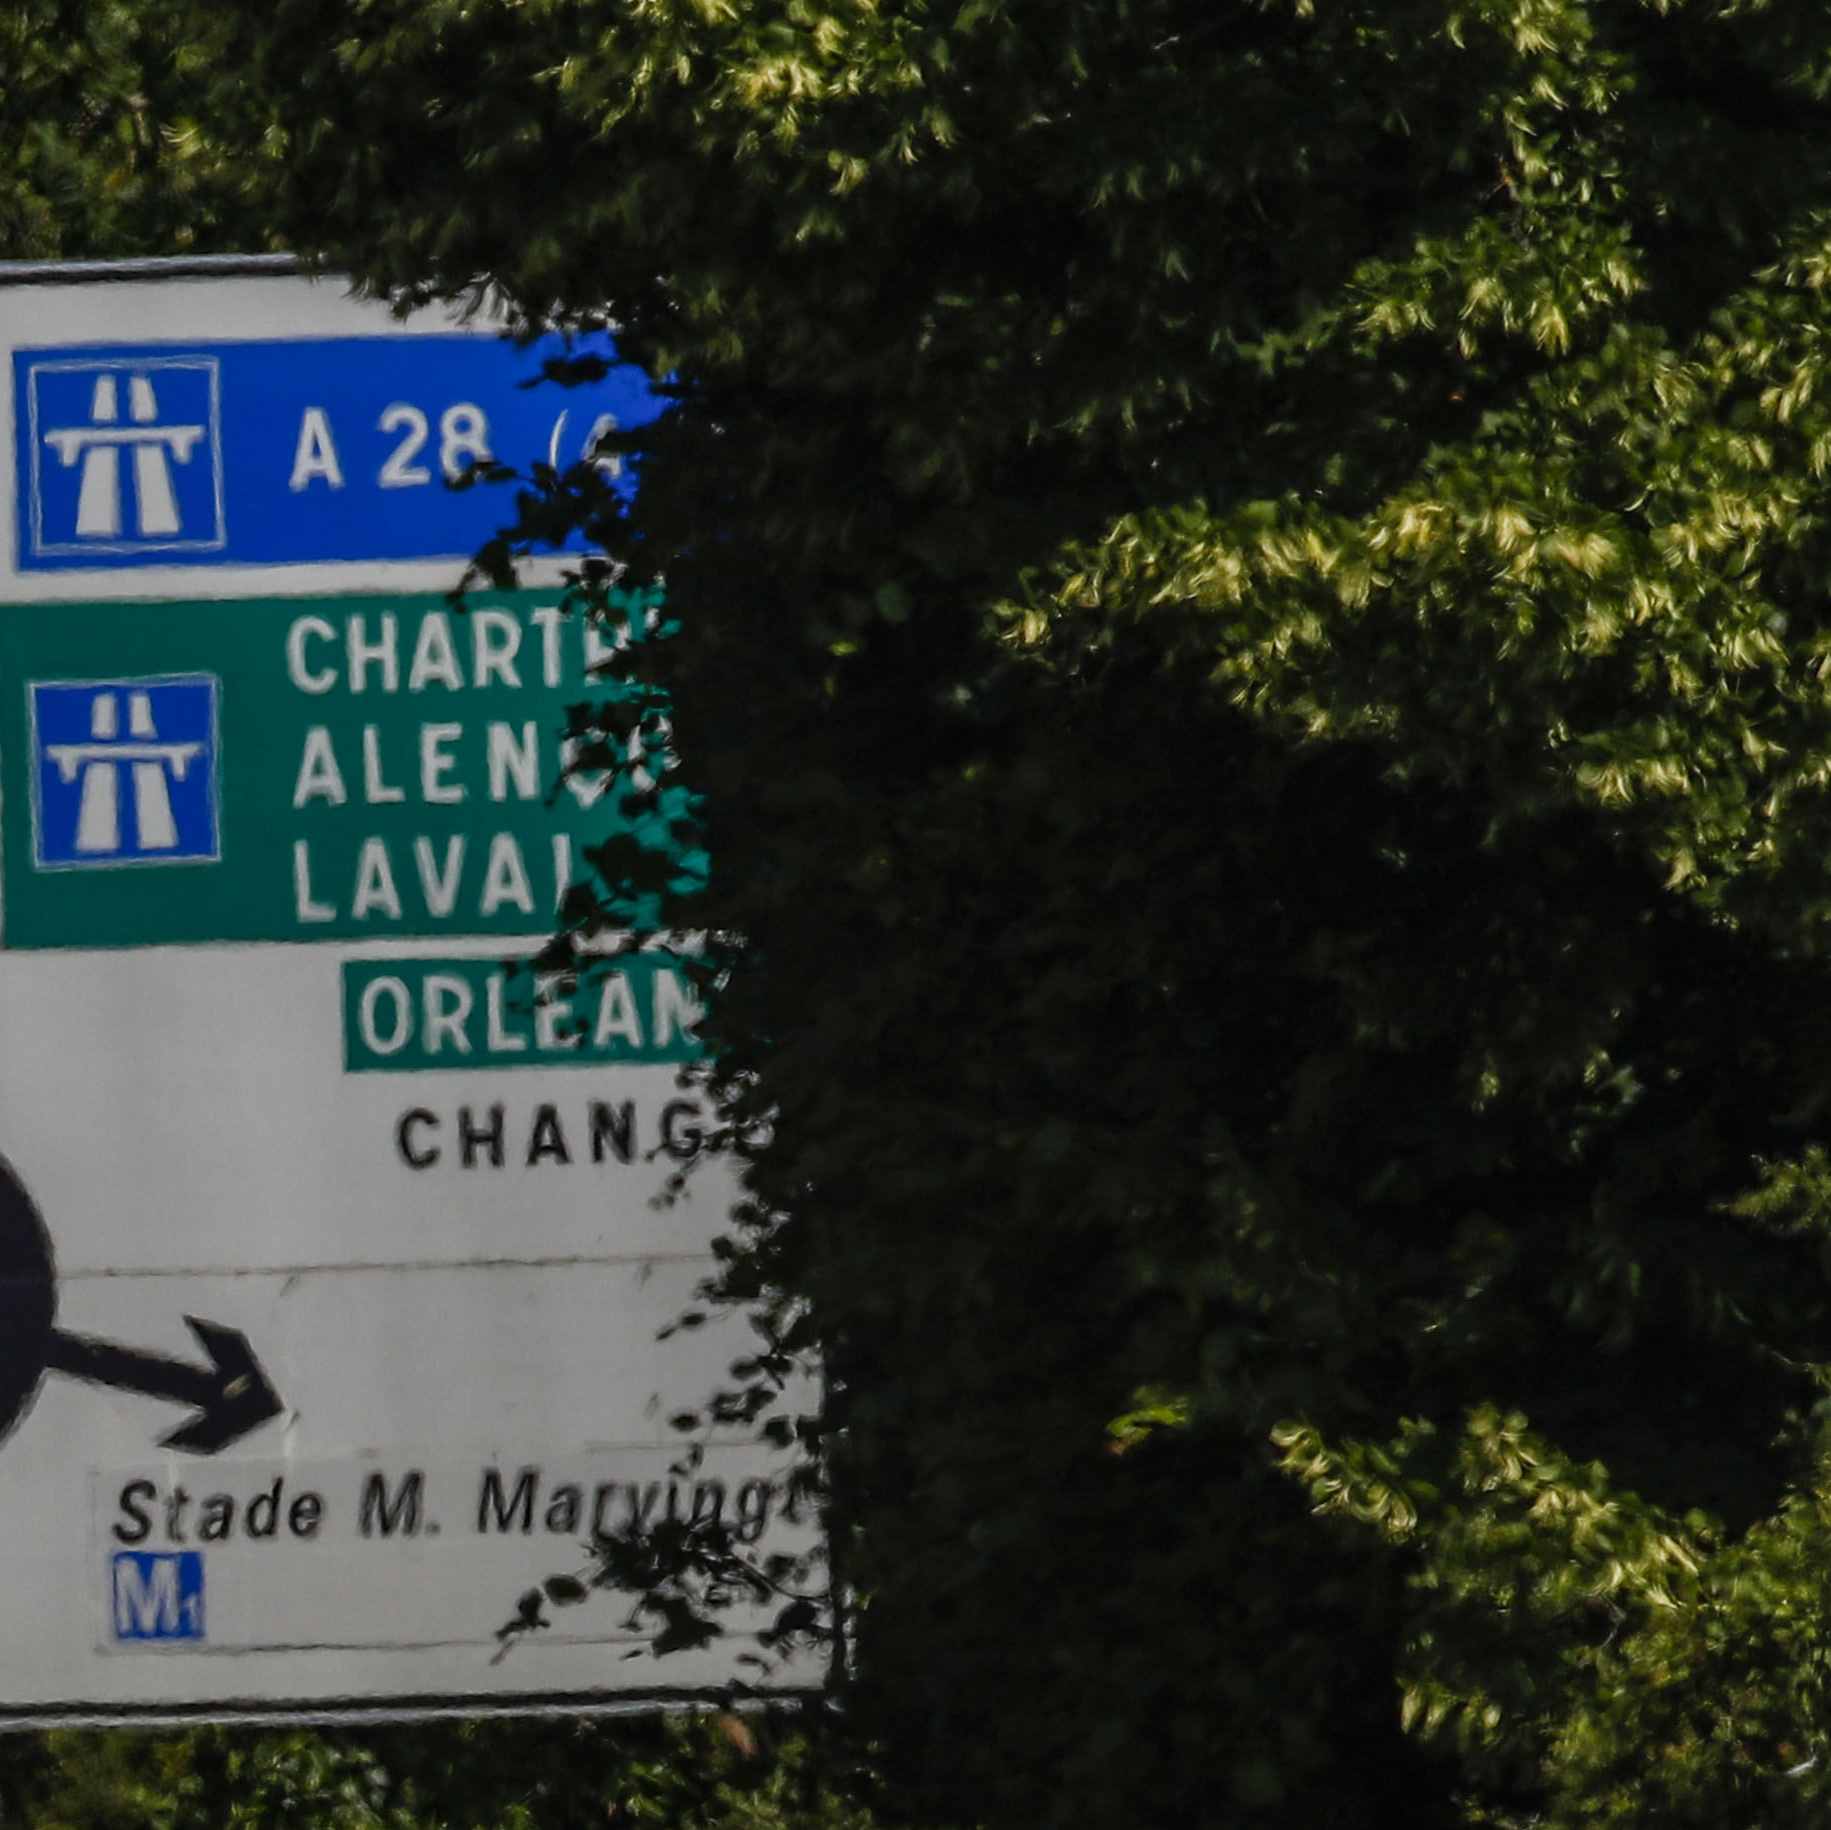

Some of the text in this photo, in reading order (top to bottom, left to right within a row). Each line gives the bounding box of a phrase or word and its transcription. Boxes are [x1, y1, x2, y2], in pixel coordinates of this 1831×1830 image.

[288, 405, 346, 492] A
[377, 401, 496, 487] 28
[358, 968, 706, 1056] ORLEAN
[397, 1098, 702, 1168] CHANG
[111, 1477, 325, 1544] Stade
[357, 1470, 441, 1538] M.
